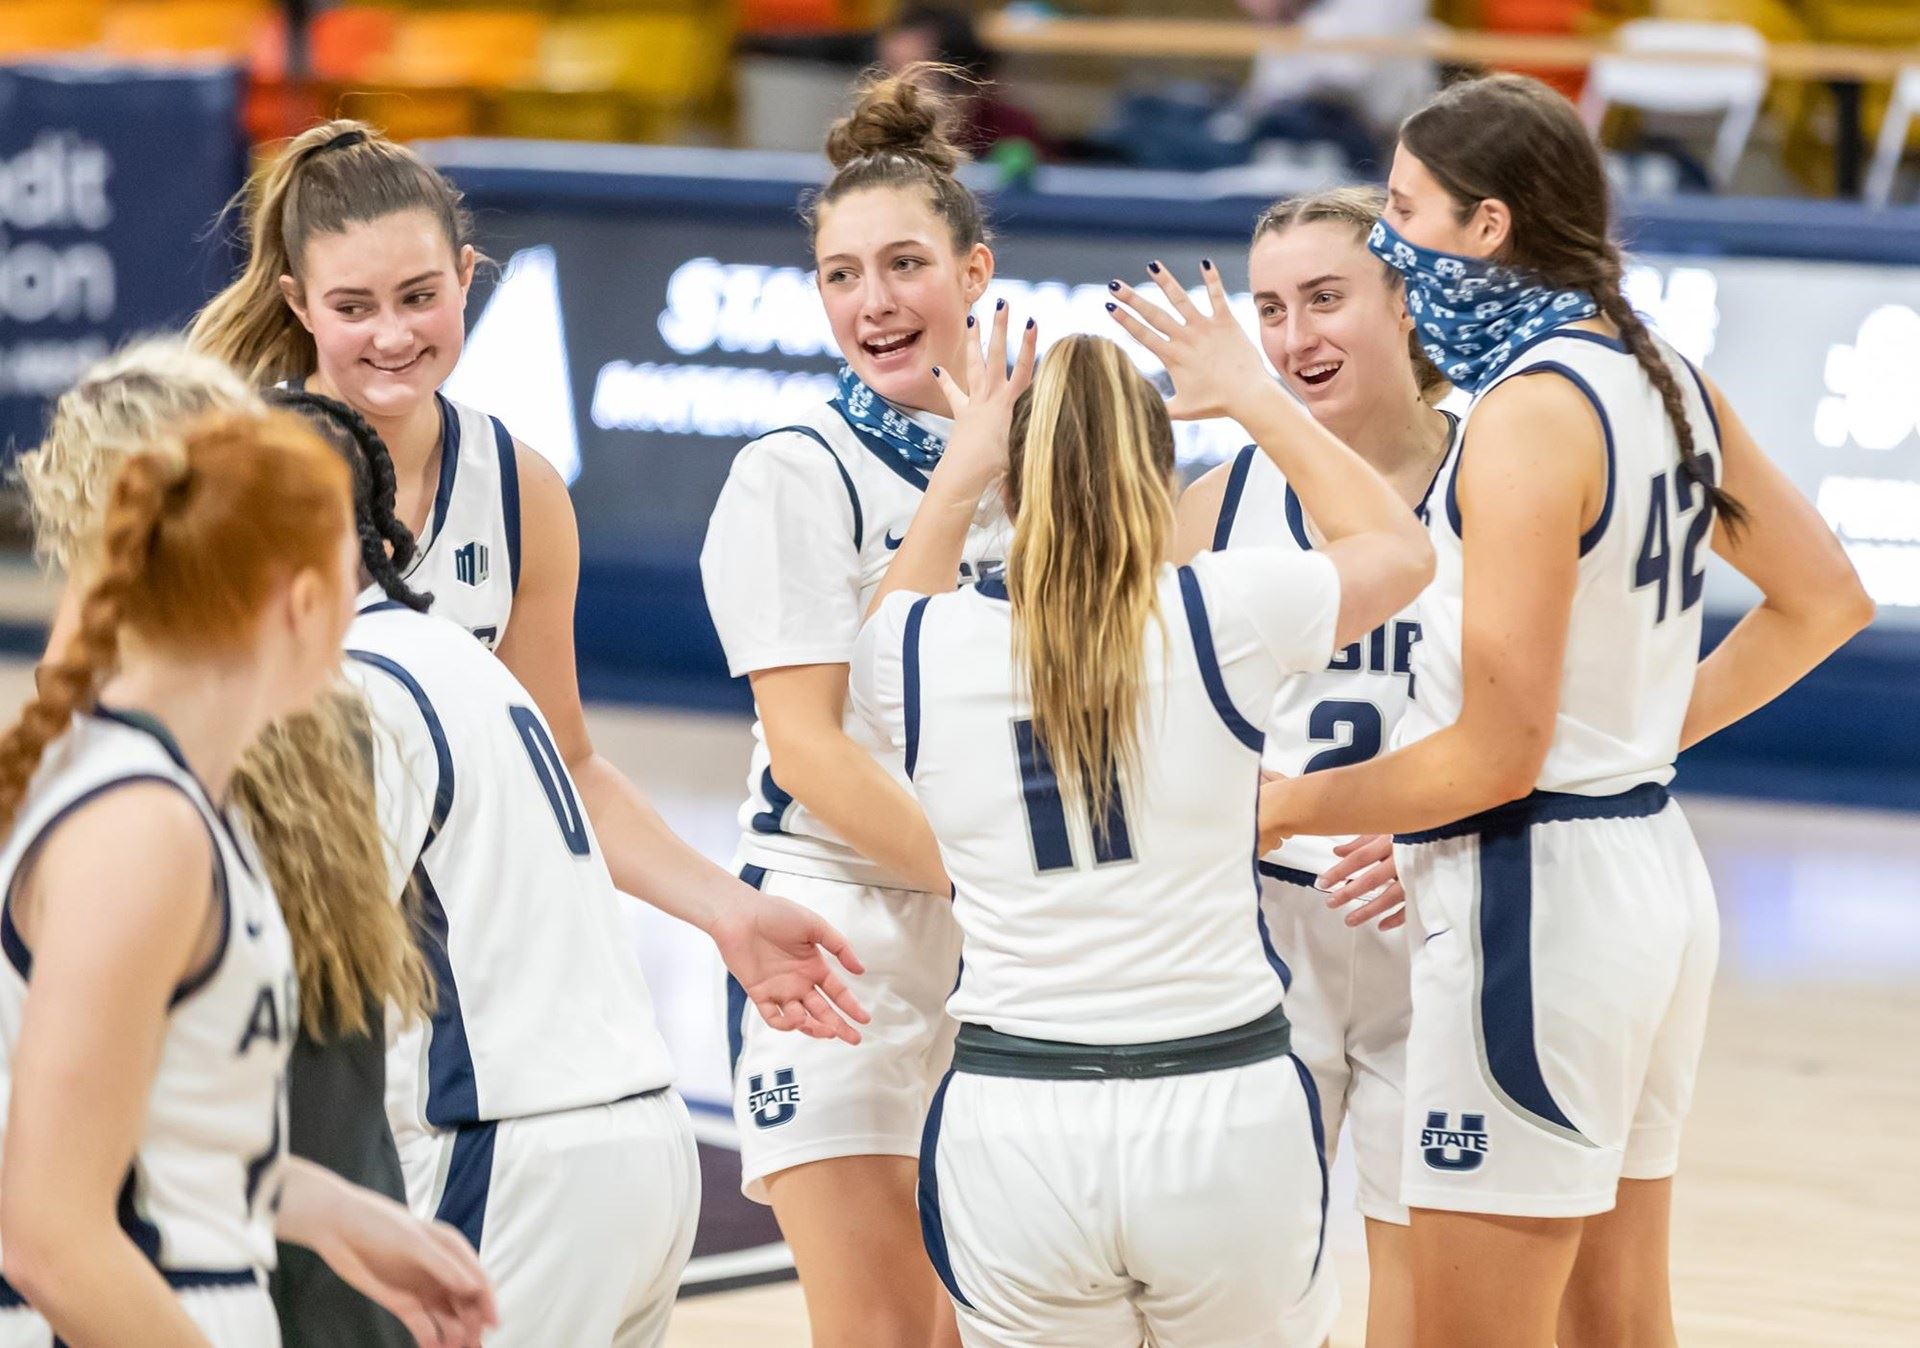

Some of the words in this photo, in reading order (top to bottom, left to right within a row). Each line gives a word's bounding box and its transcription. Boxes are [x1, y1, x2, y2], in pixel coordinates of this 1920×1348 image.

[1630, 447, 1715, 628] 42
[506, 702, 592, 862] 0
[1008, 712, 1139, 877] 11
[1302, 697, 1386, 776] 2
[748, 1085, 801, 1113] STATE
[1420, 1128, 1489, 1153] STATE
